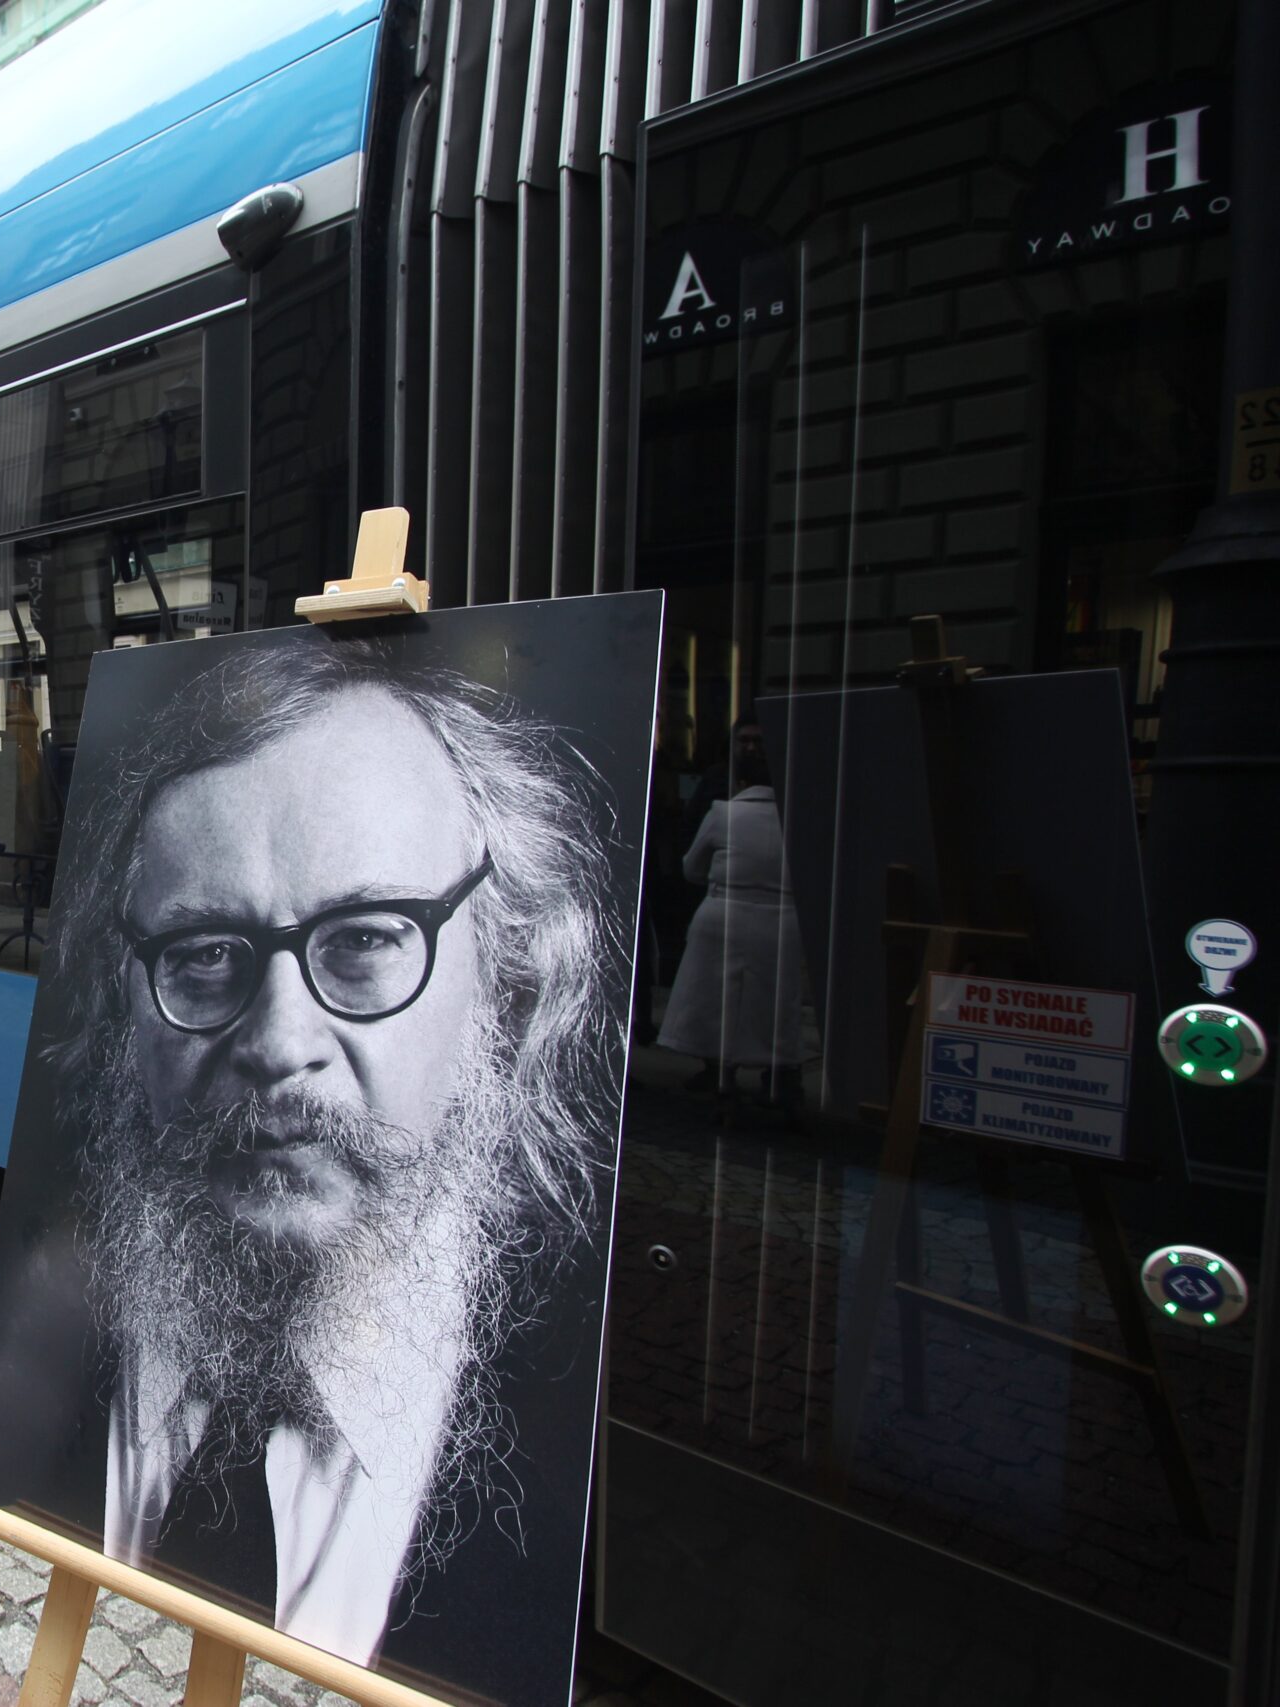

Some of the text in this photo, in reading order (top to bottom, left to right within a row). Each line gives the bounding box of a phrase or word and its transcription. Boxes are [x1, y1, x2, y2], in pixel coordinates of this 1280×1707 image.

[966, 984, 1088, 1014] PO SYGNALE
[958, 1005, 1094, 1037] NIE WSIADAĆ
[1024, 1053, 1077, 1072] POJAZD
[991, 1066, 1109, 1095] MONITOROWANY
[1021, 1102, 1074, 1122] POJAZD
[982, 1114, 1112, 1147] KLIMATYZOWANY
